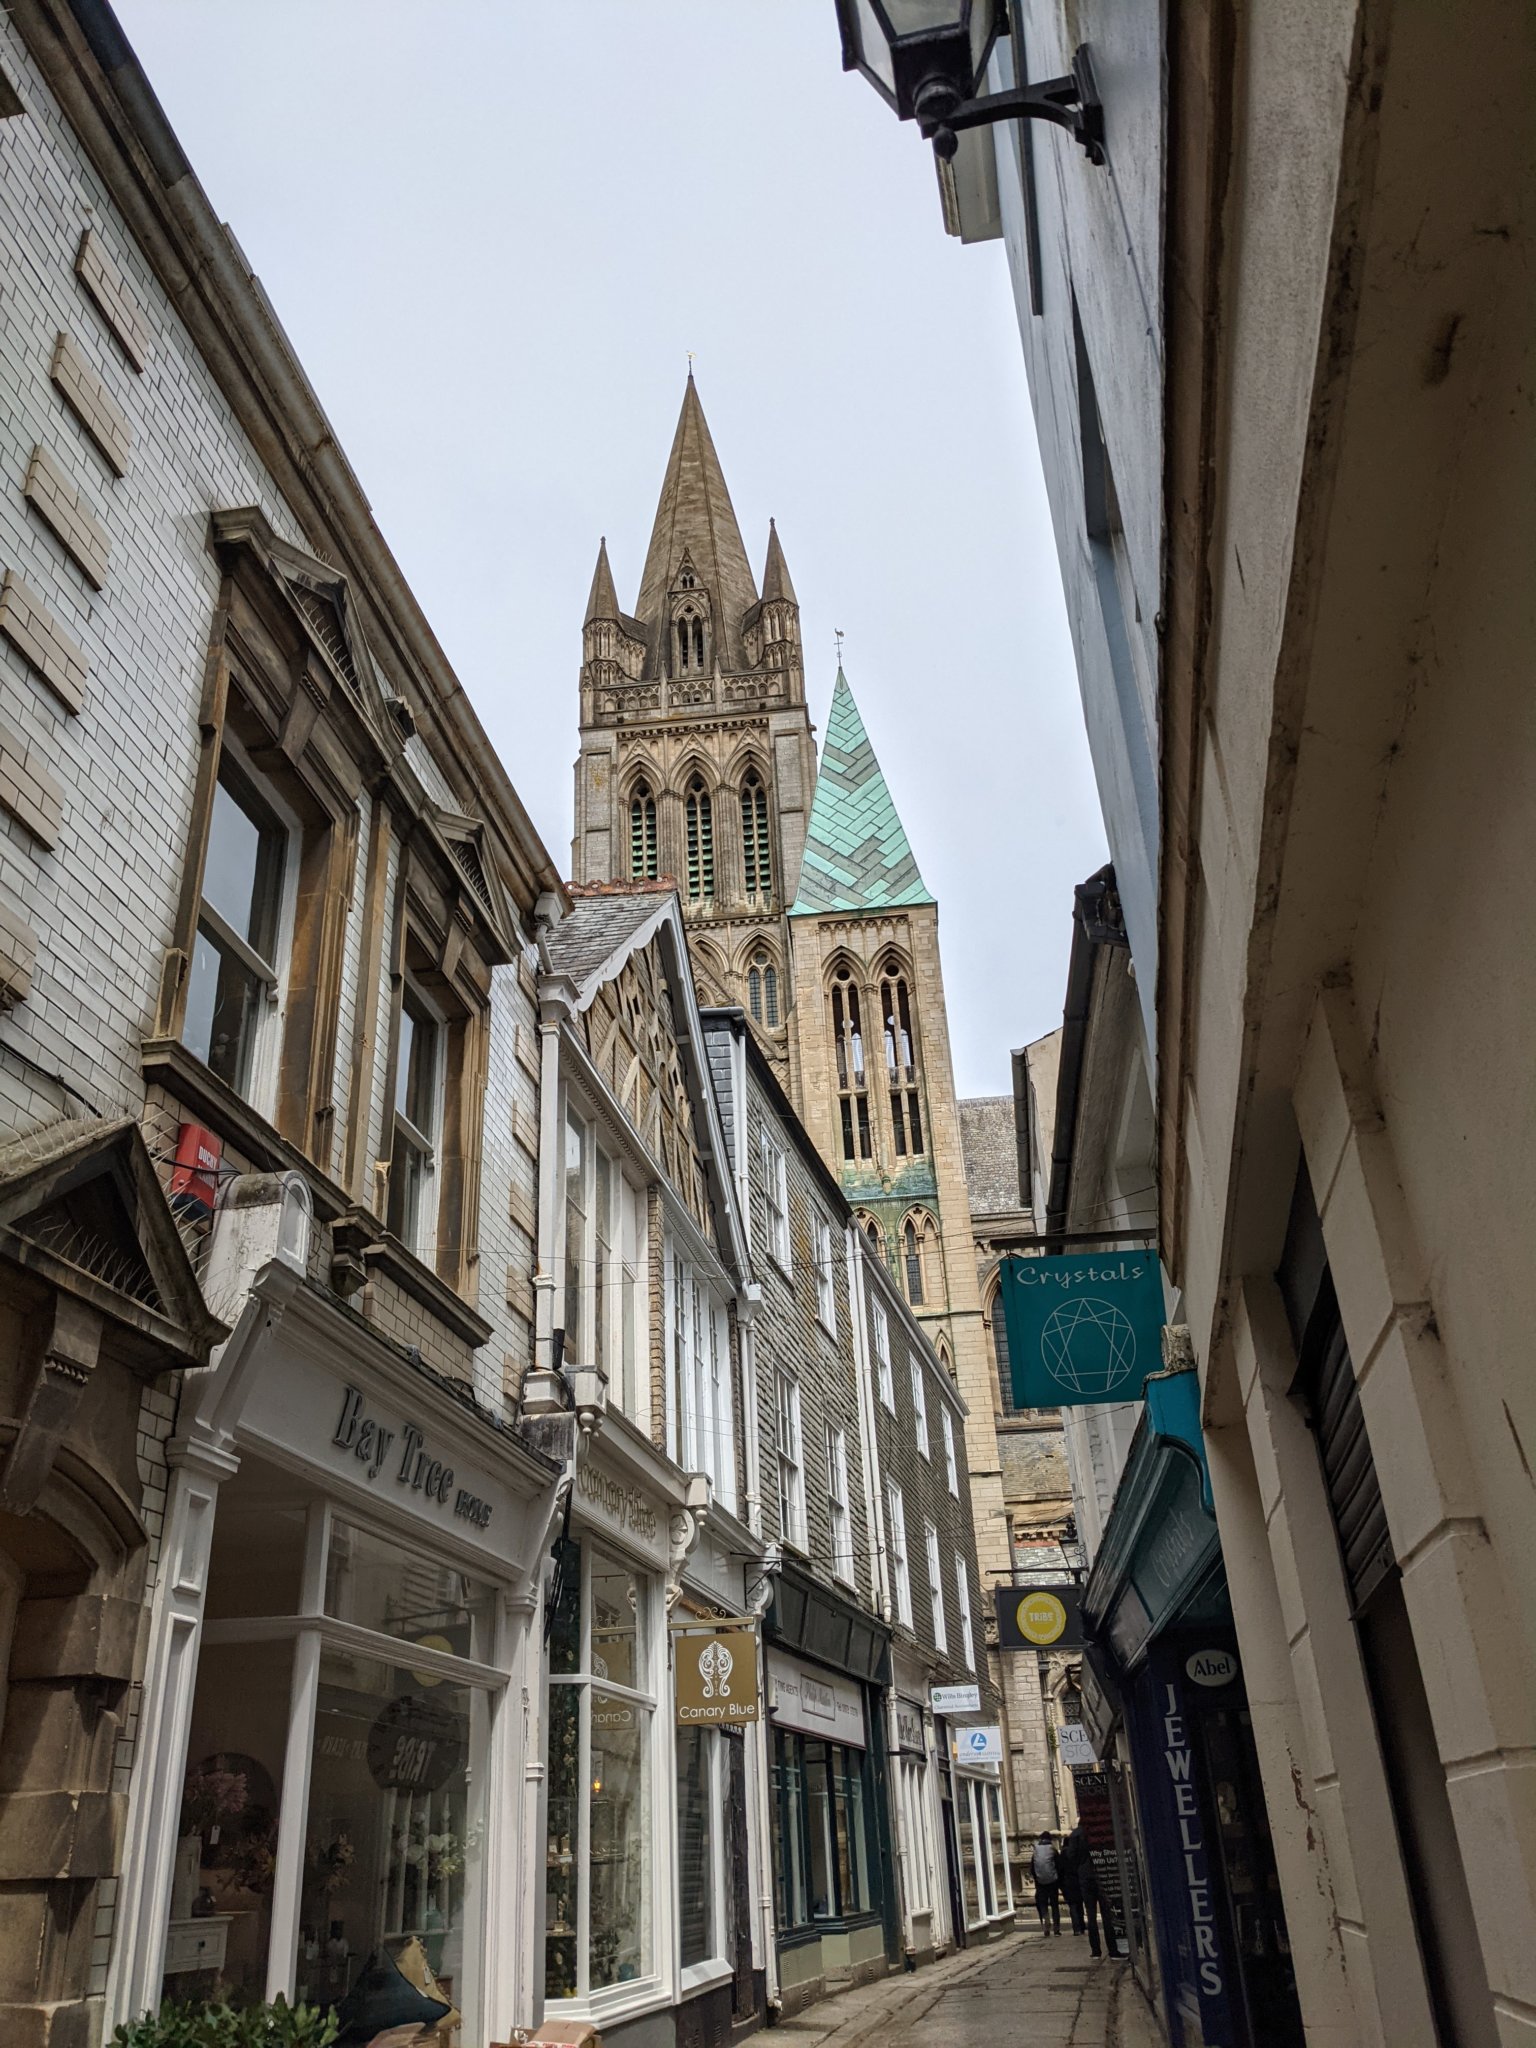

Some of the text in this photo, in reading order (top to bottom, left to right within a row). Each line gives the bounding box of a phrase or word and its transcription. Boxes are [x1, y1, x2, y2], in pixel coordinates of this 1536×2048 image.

[1016, 1262, 1144, 1289] Crystals
[332, 1384, 395, 1478] Bay
[397, 1422, 454, 1503] Tree
[1193, 1656, 1231, 1677] Abel
[680, 1703, 755, 1718] Canary Blue
[1060, 1729, 1088, 1744] SCE
[1065, 1744, 1091, 1757] STO
[1164, 1683, 1224, 1997] JEWELLERS
